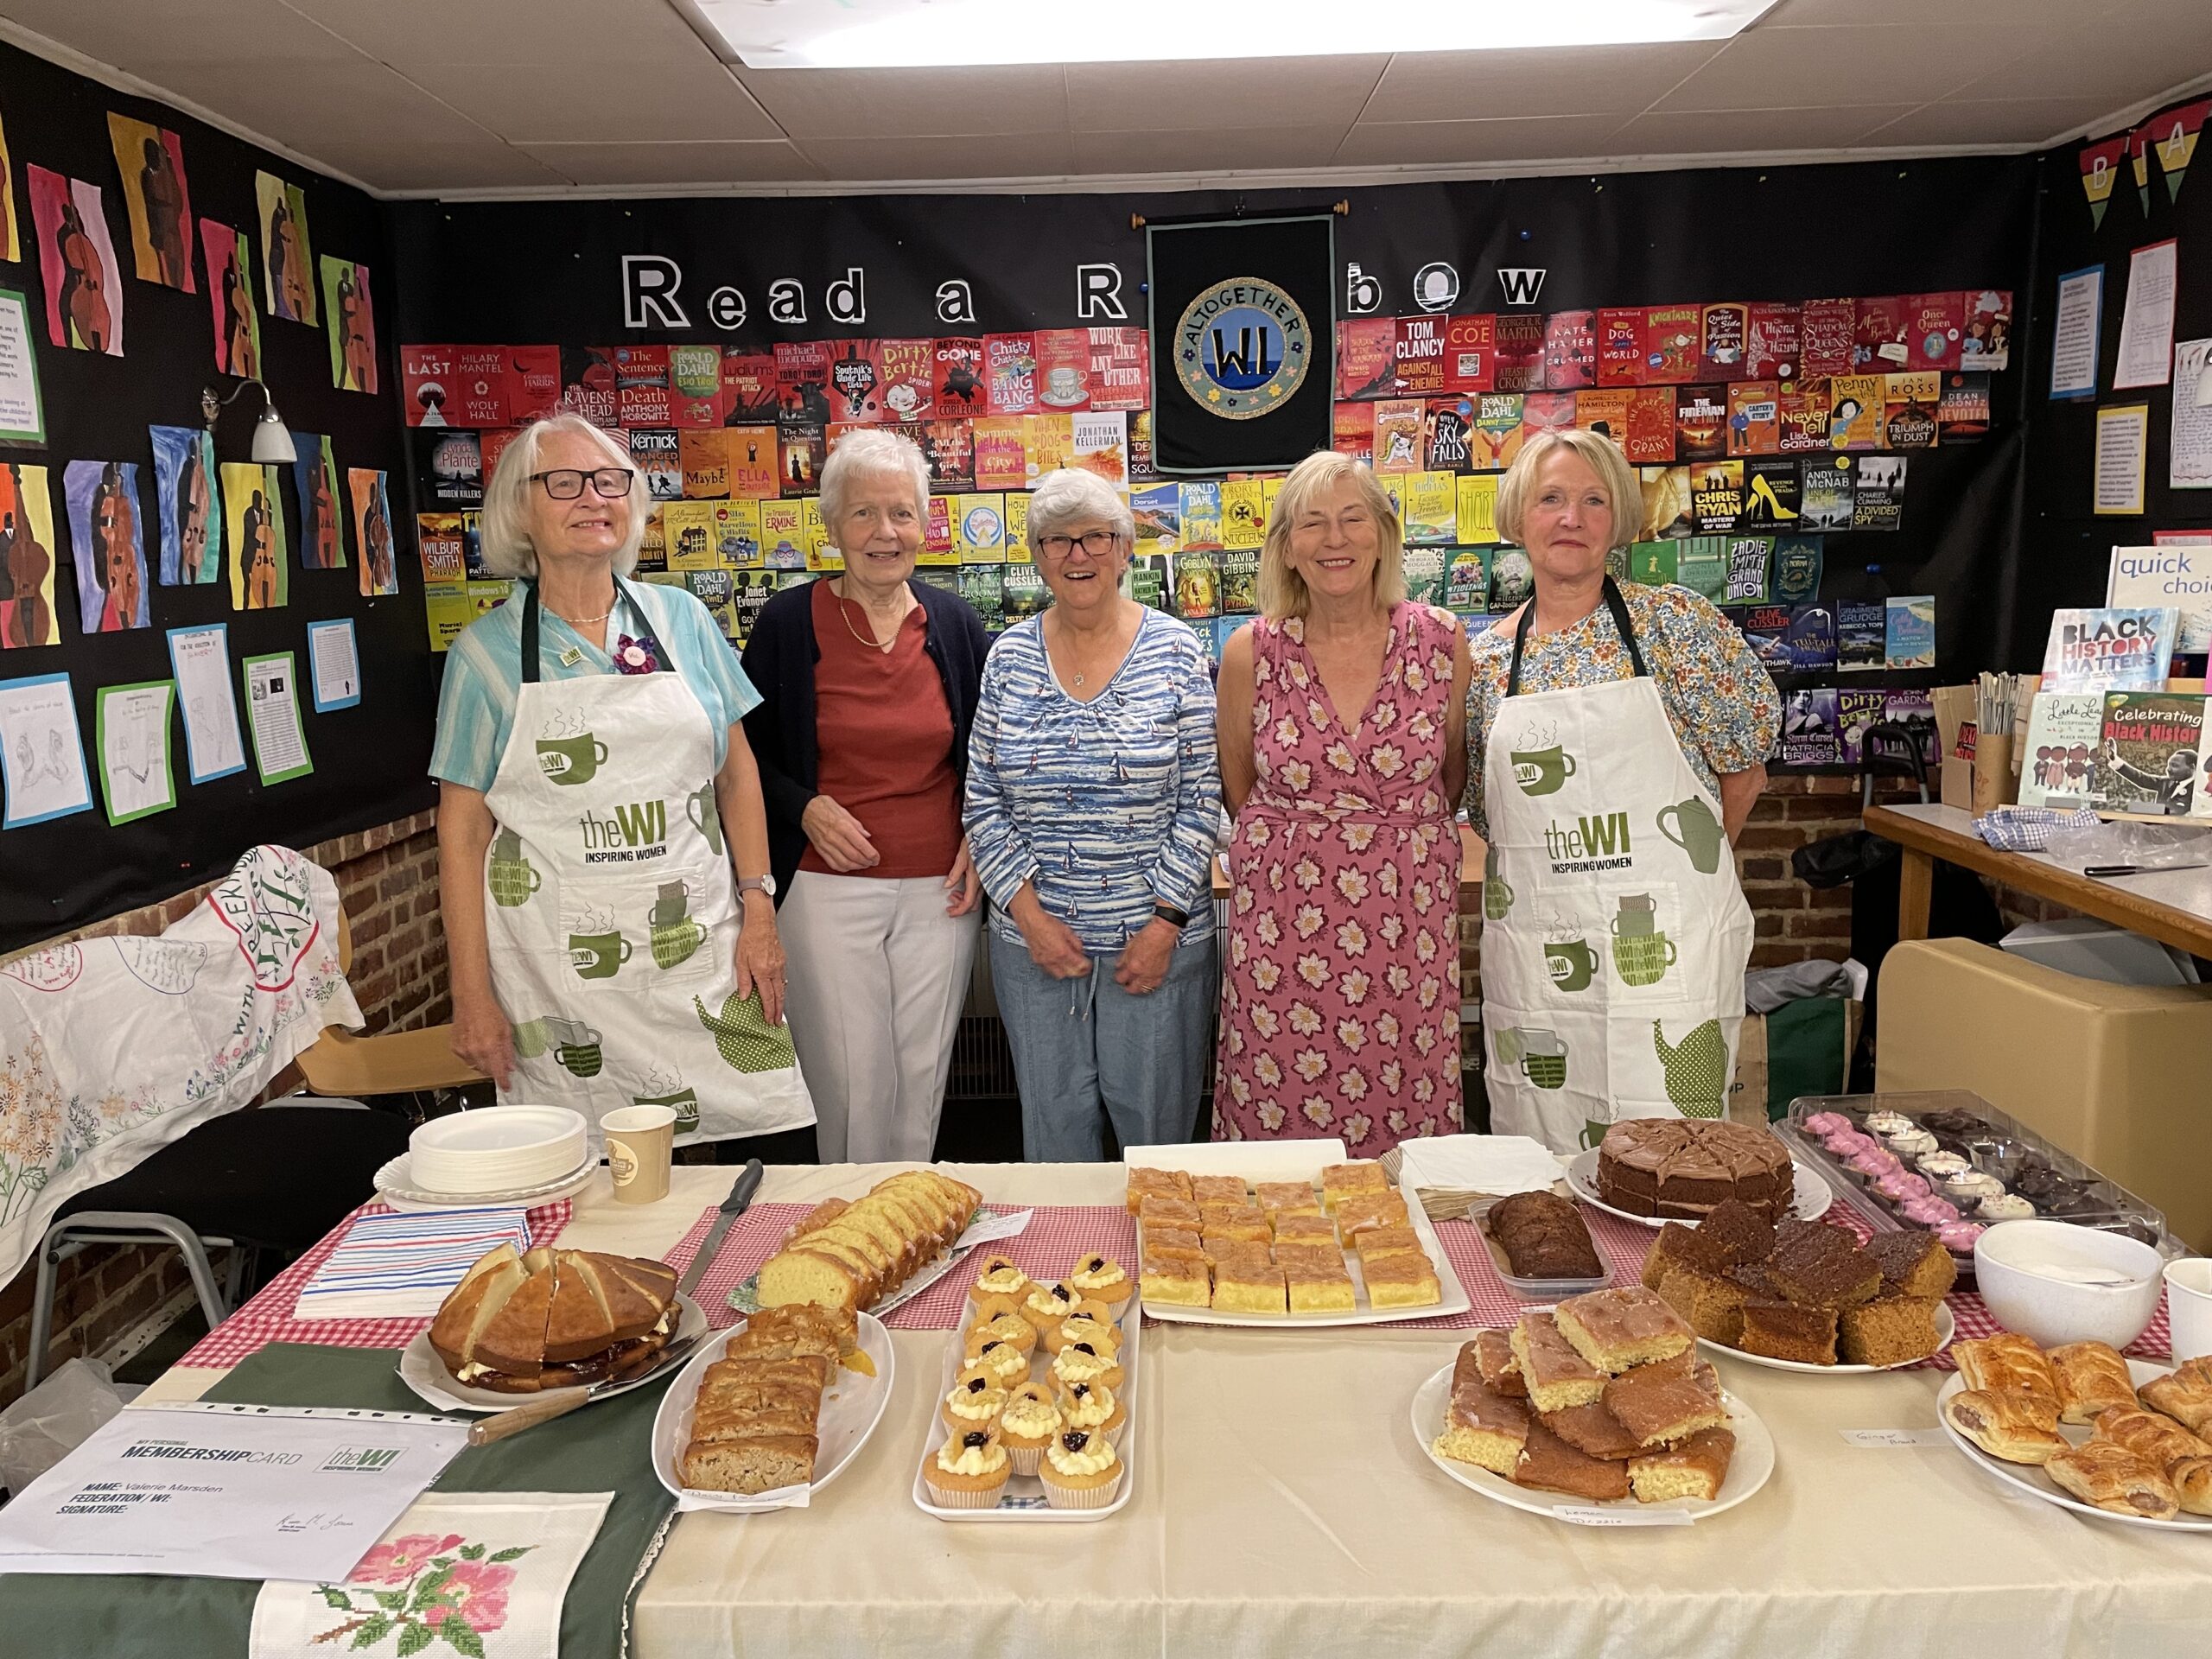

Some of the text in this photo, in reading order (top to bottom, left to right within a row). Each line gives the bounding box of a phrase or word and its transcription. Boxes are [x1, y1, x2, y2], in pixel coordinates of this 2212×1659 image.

[622, 255, 865, 330] Read
[1185, 286, 1300, 346] ALTOGETHER
[1088, 327, 1123, 346] WORK
[1407, 321, 1433, 340] TOM
[1451, 328, 1490, 344] COE
[1497, 327, 1541, 340] MARTIN
[1609, 329, 1634, 340] DOG
[937, 339, 981, 349] BEYOND
[989, 340, 1031, 356] Chitty
[1396, 339, 1445, 359] CLANCY
[461, 353, 499, 363] HILARY
[631, 351, 652, 361] The
[677, 353, 713, 364] ROALD
[883, 345, 932, 364] Dirty
[936, 348, 982, 361] GONE
[1113, 345, 1136, 360] LIKE
[1603, 349, 1639, 359] WORLD
[409, 362, 450, 375] LAST
[459, 363, 504, 373] MANTEL
[617, 363, 665, 373] Sentence
[677, 364, 715, 376] DAHL
[1090, 355, 1113, 372] ANY
[1397, 362, 1444, 376] AGAINST ALL
[880, 361, 932, 382] Bertie
[1103, 368, 1141, 387] OTHER
[736, 377, 758, 385] PATRIOT
[992, 374, 1033, 391] BANG
[1891, 384, 1934, 395] ROSS
[564, 391, 615, 404] RAVEN'S
[621, 390, 666, 404] Death
[993, 390, 1034, 404] BANG
[1482, 397, 1515, 407] ROALD
[1694, 398, 1710, 407] THE
[467, 401, 499, 410] WOLF
[579, 404, 613, 417] HEAD
[620, 404, 669, 414] ANTHONY
[938, 404, 985, 416] CORLEONE
[1481, 407, 1515, 417] DAHL
[1680, 406, 1725, 417] FIREMAN
[469, 410, 498, 420] HALL
[620, 412, 671, 422] HOROWITZ
[1780, 411, 1829, 424] Never
[1033, 418, 1059, 432] WHEN
[1077, 427, 1118, 436] JONATHAN
[1888, 423, 1934, 433] TRIUMPH
[798, 429, 819, 437] Night
[976, 429, 1023, 438] Summer
[1435, 421, 1459, 443] SKY
[1790, 432, 1808, 441] Lisa
[1904, 432, 1929, 442] DUST
[632, 434, 677, 450] Kernick
[1040, 432, 1061, 447] DOG
[1076, 436, 1121, 447] KELLERMAN
[1631, 438, 1671, 454] GRANT
[1780, 438, 1829, 449] Gardner
[927, 448, 972, 458] Beautiful
[1433, 439, 1465, 464] FALLS
[442, 453, 479, 467] Plante
[987, 456, 1013, 469] City
[738, 469, 770, 482] ELLA
[1807, 471, 1832, 480] ANDY
[1185, 483, 1215, 496] ROALD
[1228, 485, 1252, 494] RORY
[1807, 479, 1850, 488] McNAB
[1188, 494, 1213, 506] DAHL
[1694, 491, 1740, 504] CHRIS
[1007, 500, 1026, 510] HOW
[1695, 502, 1742, 518] RYAN
[1863, 506, 1898, 515] DIVIDED
[766, 518, 798, 531] ERMINE
[1854, 515, 1873, 525] SPY
[1224, 532, 1265, 545] NUCLEUS
[423, 542, 460, 556] WILBUR
[1731, 540, 1768, 559] ZADIE
[428, 556, 459, 569] SMITH
[1227, 552, 1255, 563] DAVID
[1729, 554, 1765, 572] SMITH
[1010, 566, 1036, 576] CLIVE
[1223, 563, 1261, 575] GIBBINS
[2120, 552, 2191, 578] quick
[693, 573, 727, 584] ROALD
[1004, 576, 1044, 587] CUSSLER
[1134, 572, 1160, 582] RANKIN
[1726, 569, 1764, 584] GRAND
[468, 587, 499, 597] Windows
[696, 583, 725, 595] DAHL
[745, 586, 767, 598] Janet
[1447, 582, 1487, 593] WILDLINGS
[1727, 582, 1764, 601] UNION
[2163, 577, 2212, 594] choi
[1755, 608, 1781, 619] CLIVE
[1840, 613, 1885, 623] GRUDGE
[1747, 617, 1789, 629] CUSSLER
[2063, 615, 2156, 643] BLACK
[2063, 636, 2156, 659] HISTORY
[2062, 652, 2156, 675] MATTERS
[1840, 692, 1887, 712] Dirty
[2048, 697, 2080, 721] Little
[2114, 709, 2202, 728] Celebrating
[2103, 721, 2200, 743] Black Histor
[1784, 751, 1834, 760] BRIGGS
[586, 845, 667, 863] INSPIRING WOMEN
[1552, 857, 1632, 874] INSPIRING WOMEN
[232, 984, 256, 1035] WITH
[82, 1482, 122, 1491] NAME:
[169, 1484, 223, 1493] Marsden
[69, 1493, 145, 1503] FEDERATION
[149, 1494, 172, 1503] WI:
[56, 1504, 128, 1514] SIGNATURE:
